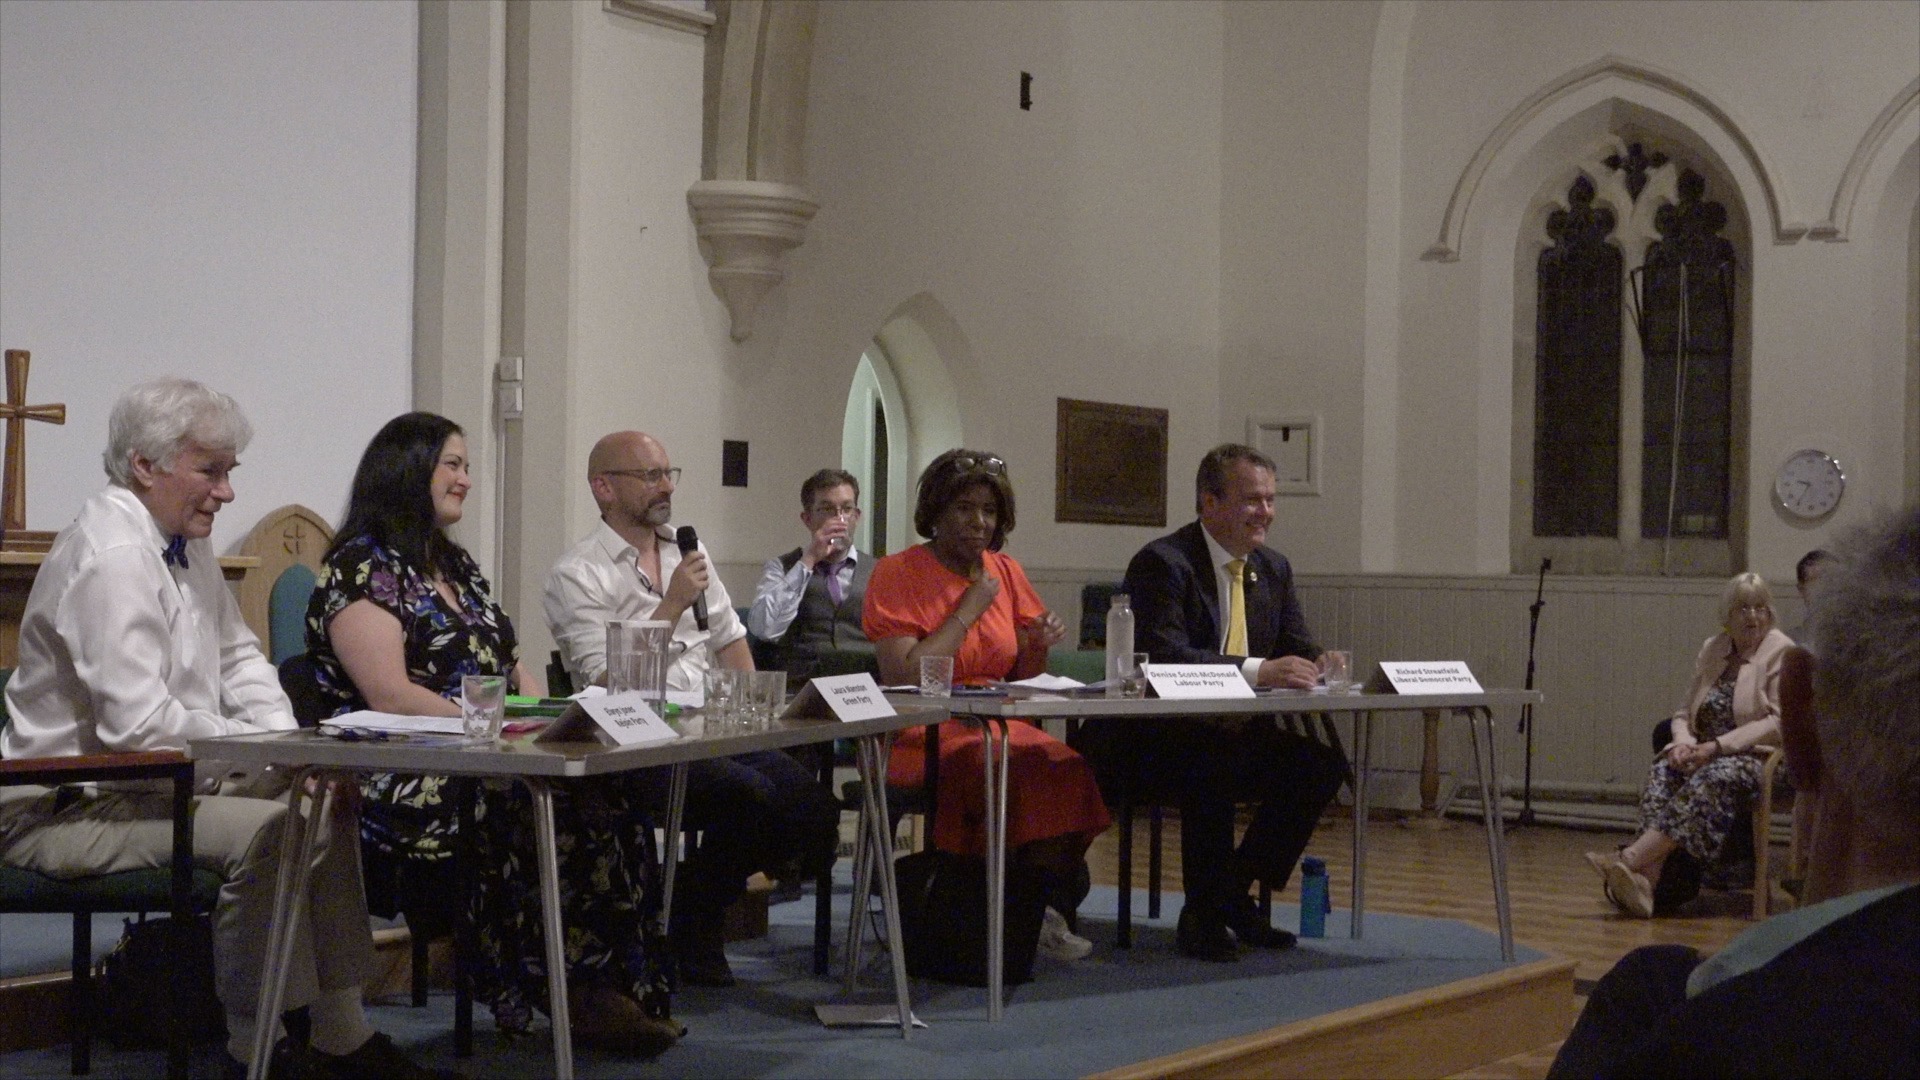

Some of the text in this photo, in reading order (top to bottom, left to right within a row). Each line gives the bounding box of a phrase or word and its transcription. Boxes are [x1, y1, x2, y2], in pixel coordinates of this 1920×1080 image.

[1150, 671, 1177, 679] Denise
[1202, 680, 1224, 688] Party
[1451, 676, 1472, 684] Party
[831, 686, 847, 695] Laura
[842, 695, 873, 706] Green Party
[630, 717, 649, 726] Party
